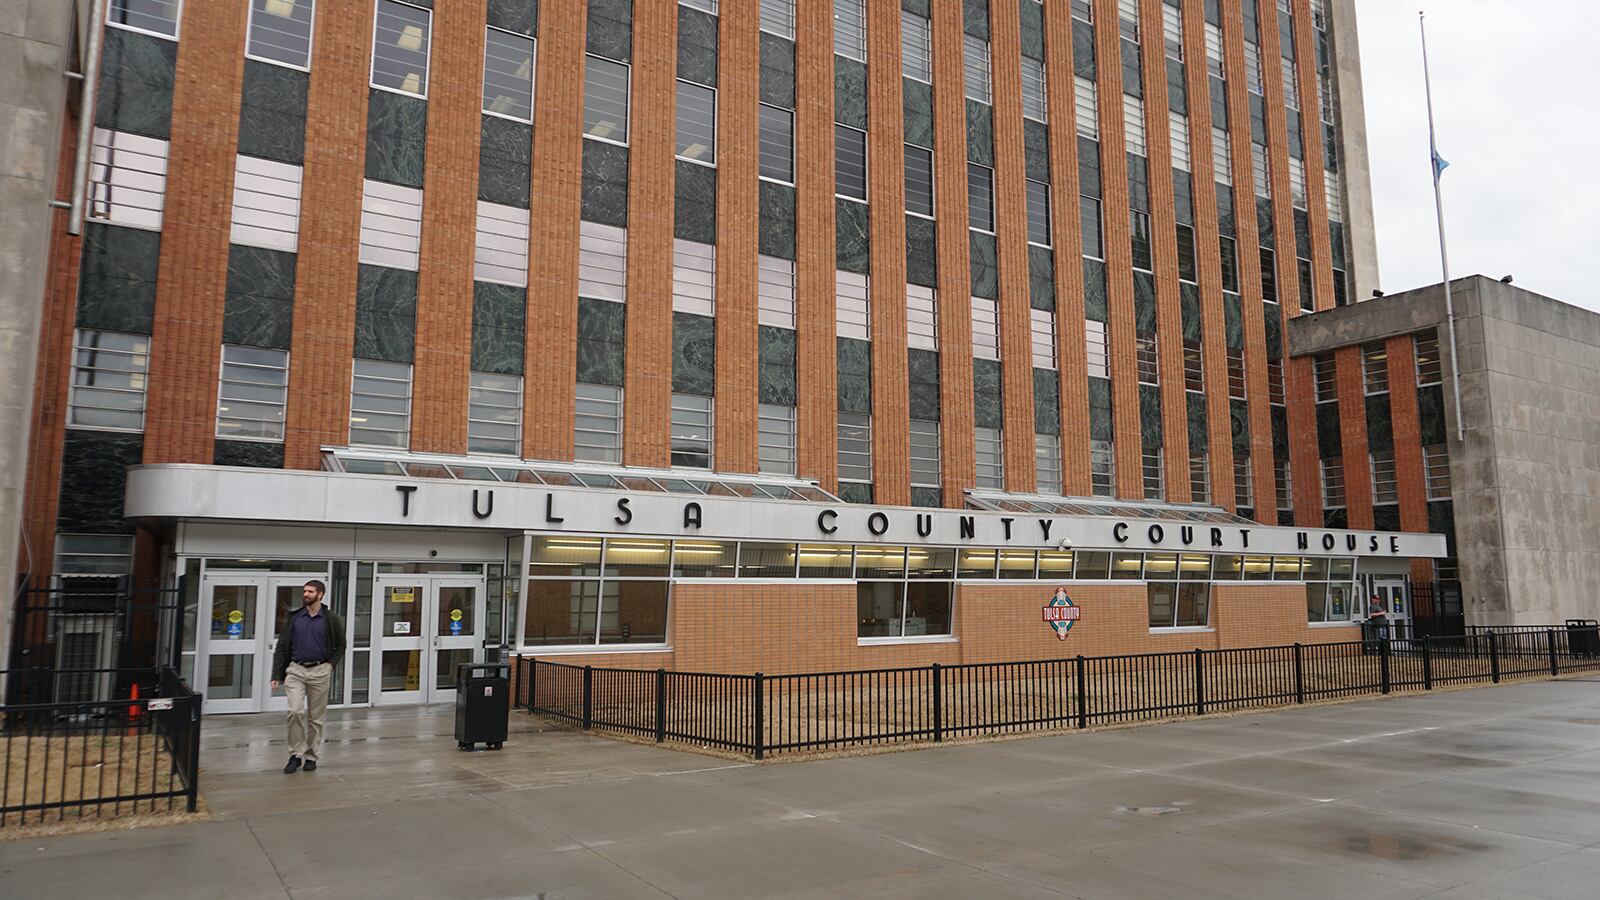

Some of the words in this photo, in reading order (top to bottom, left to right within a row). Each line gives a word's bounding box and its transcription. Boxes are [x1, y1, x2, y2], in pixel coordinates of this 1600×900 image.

[396, 485, 702, 529] TULSA
[818, 509, 1053, 541] COUNTY
[1113, 522, 1250, 548] COURT
[1297, 531, 1399, 553] HOUSE
[1043, 607, 1060, 620] TULSA
[1060, 607, 1080, 620] COUNTY
